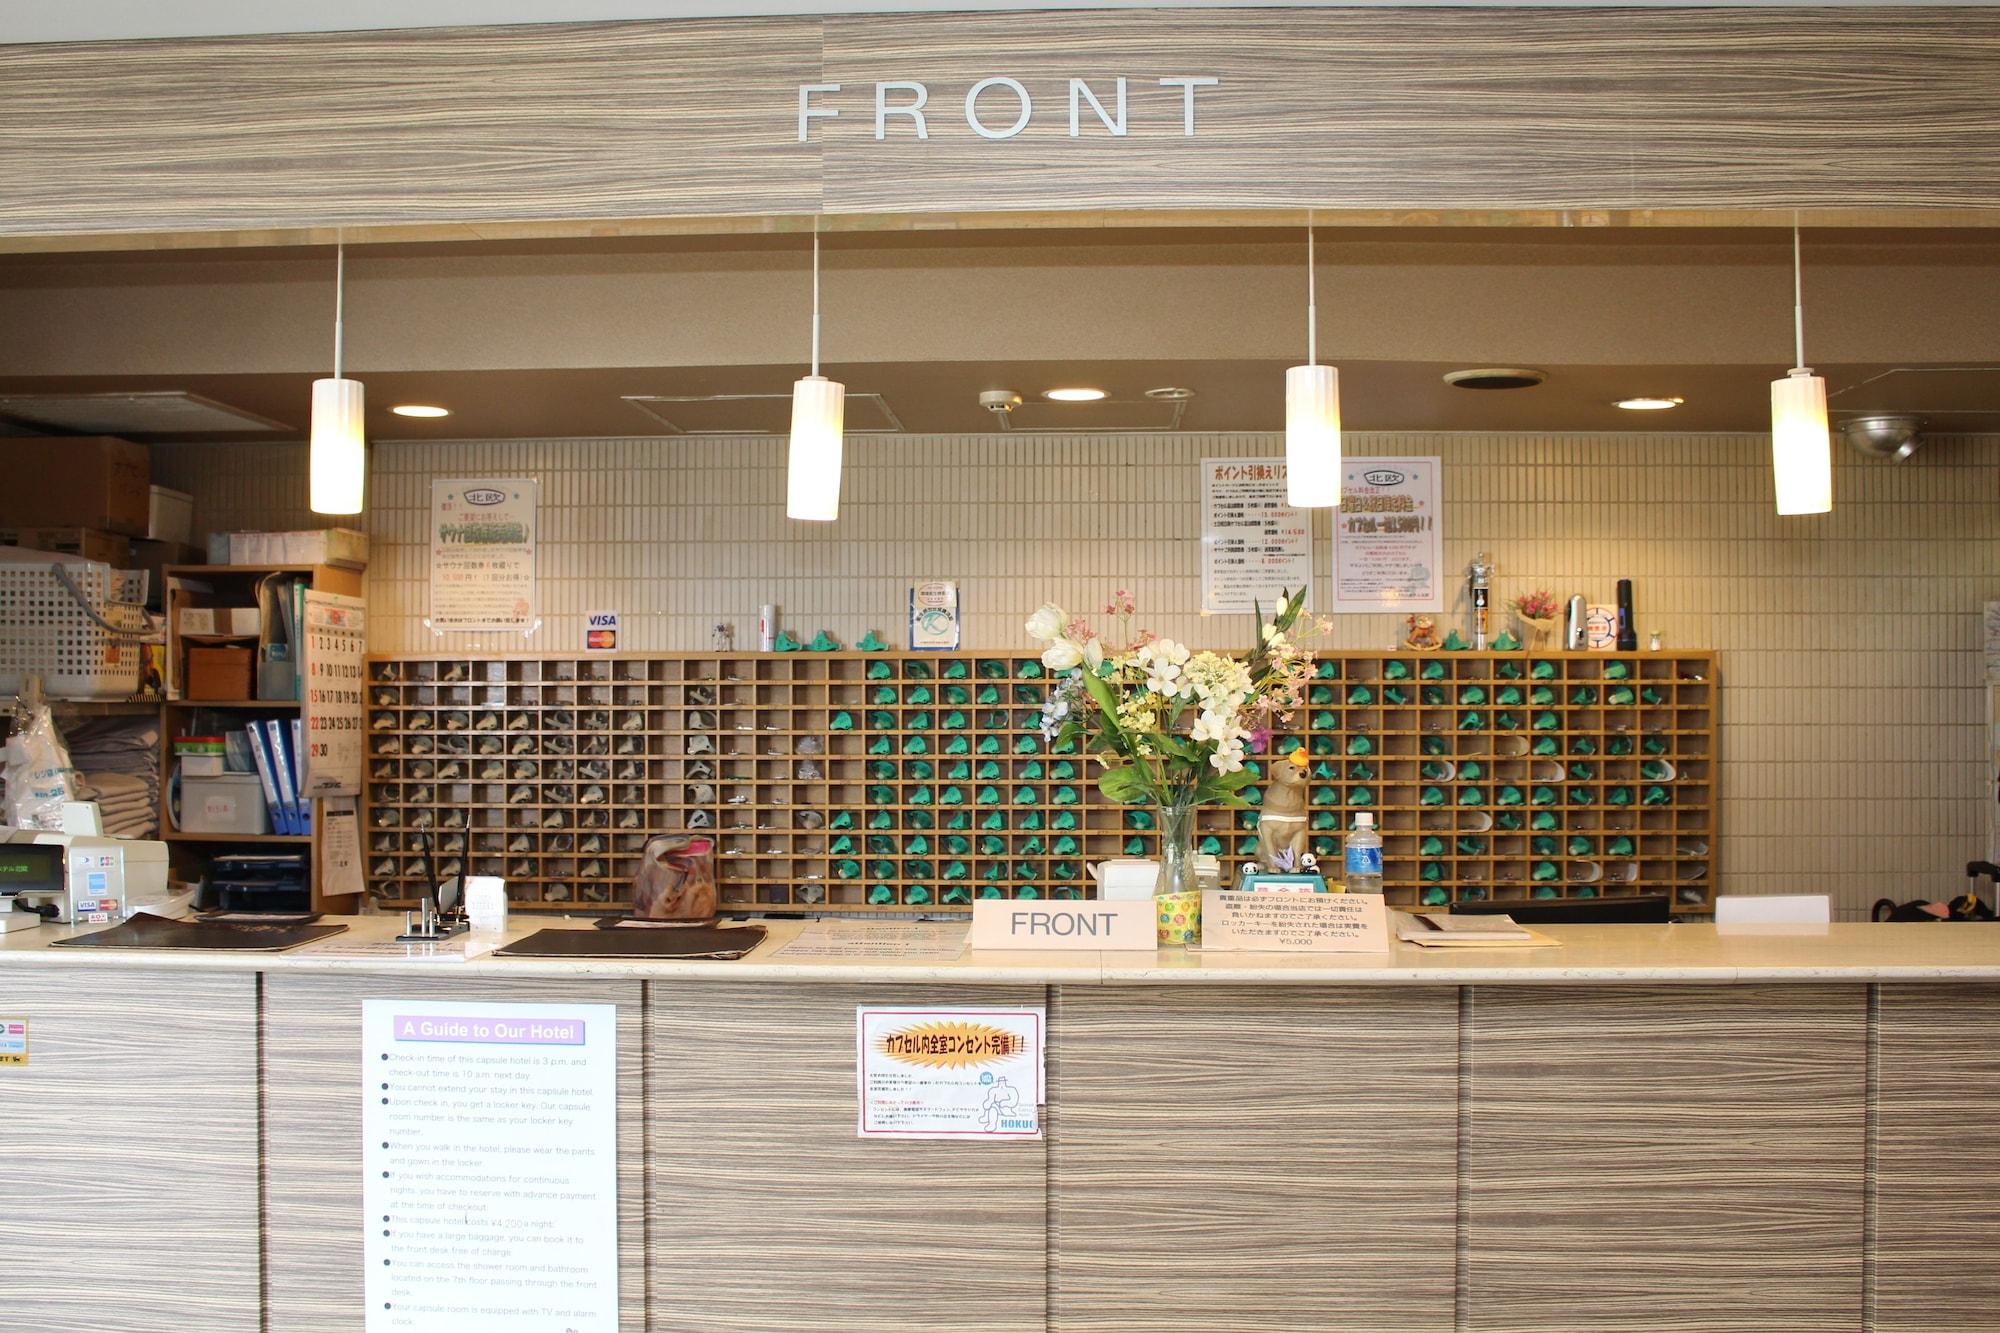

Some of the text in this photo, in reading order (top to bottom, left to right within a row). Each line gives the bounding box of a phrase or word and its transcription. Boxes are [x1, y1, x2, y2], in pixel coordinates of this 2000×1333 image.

[798, 76, 1219, 142] FRONT
[589, 615, 617, 626] VISA
[312, 636, 362, 652] 1 2 3 4 5 6 7
[320, 664, 324, 676] 9
[326, 664, 332, 676] 10
[334, 664, 340, 677] 11
[342, 664, 348, 678] 12
[350, 665, 356, 678] 13
[311, 689, 358, 704] 15 16 17 18 19 20
[311, 717, 358, 730] 22 23 24 25 26 27
[312, 744, 328, 757] 29 30
[1011, 912, 1118, 936] FRONT
[403, 1021, 574, 1039] A Guide to Our Hotel
